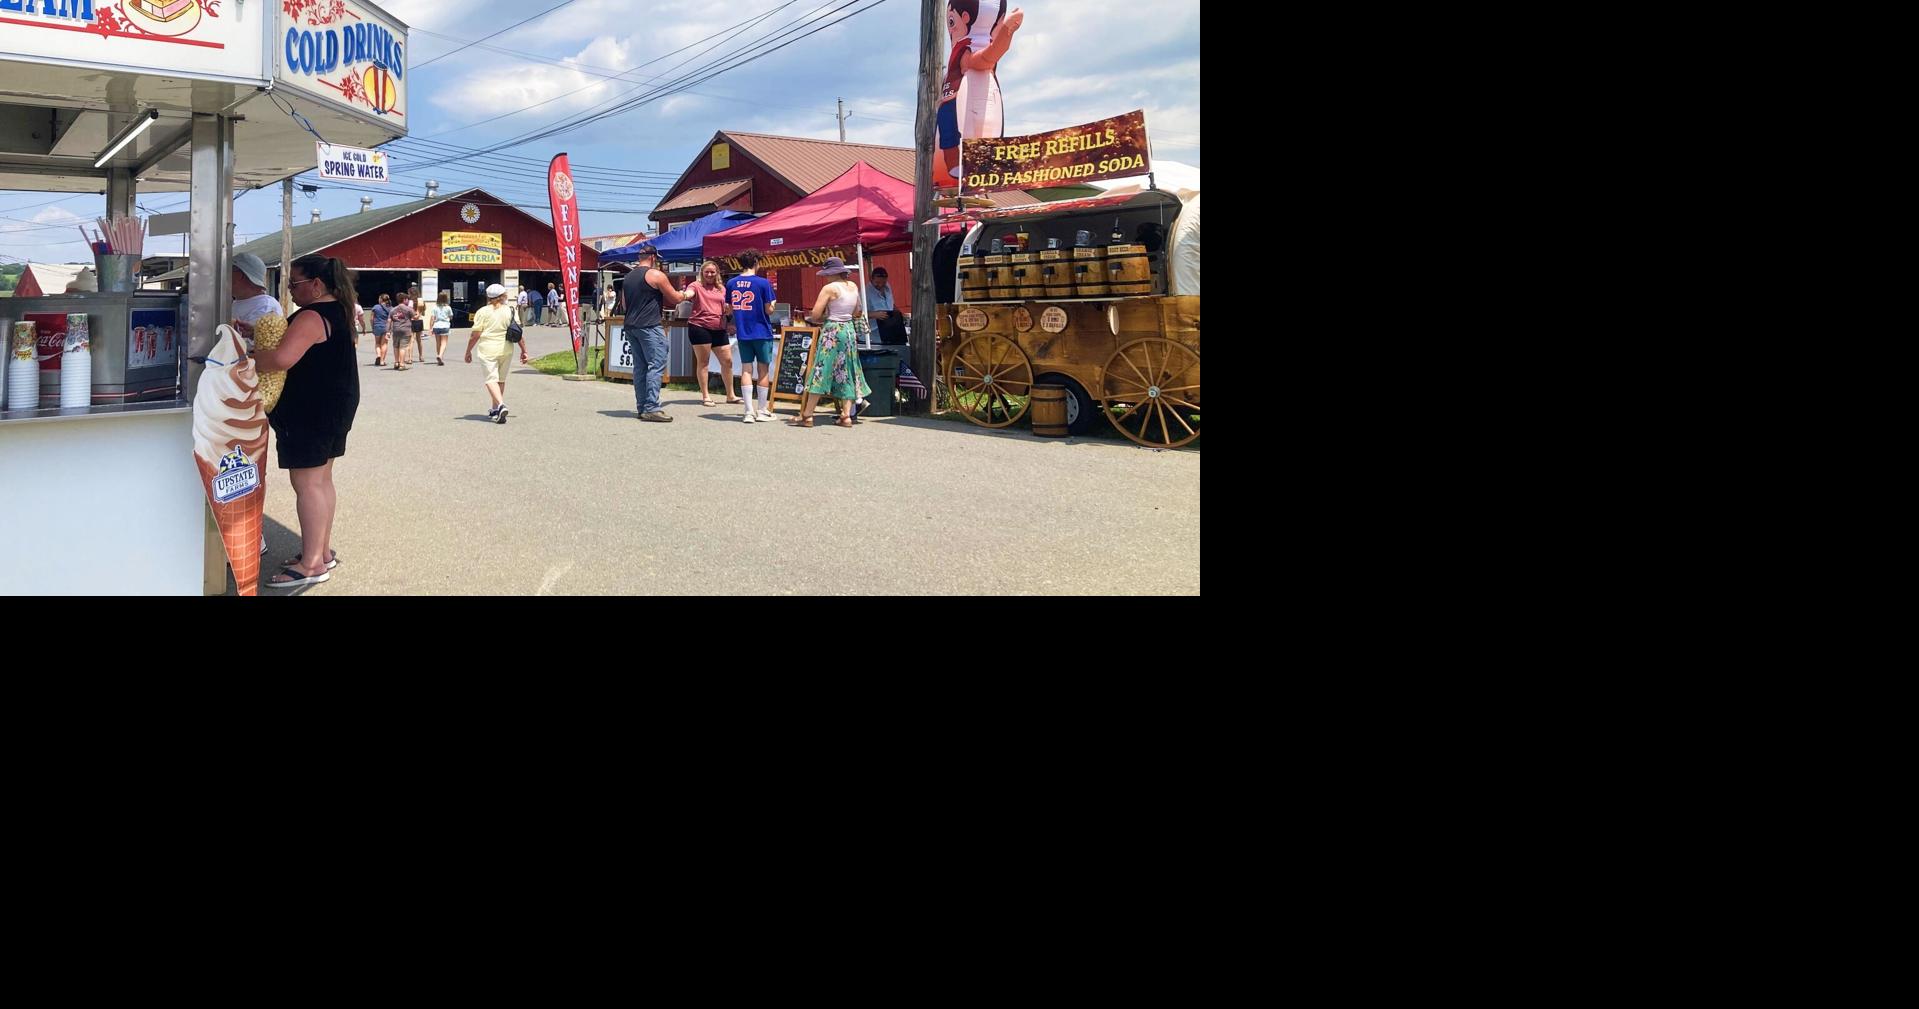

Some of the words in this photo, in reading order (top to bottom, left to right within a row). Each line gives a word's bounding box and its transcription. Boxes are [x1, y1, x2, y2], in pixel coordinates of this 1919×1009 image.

[285, 27, 340, 75] COLD
[343, 22, 403, 80] DRINKS
[994, 140, 1041, 161] FREE
[1045, 128, 1115, 156] REFILLS
[343, 151, 352, 161] ICE
[353, 152, 367, 163] COLD
[324, 159, 355, 177] SPRING
[357, 163, 384, 179] WATER
[968, 173, 1000, 187] OLD
[1003, 163, 1095, 186] FASHIONED
[1098, 153, 1145, 174] SODA
[448, 254, 496, 263] CAFETERIA
[559, 204, 580, 326] FUNNEL
[731, 289, 755, 311] 22
[217, 468, 255, 491] UPSTATE
[225, 480, 249, 494] FARMS
